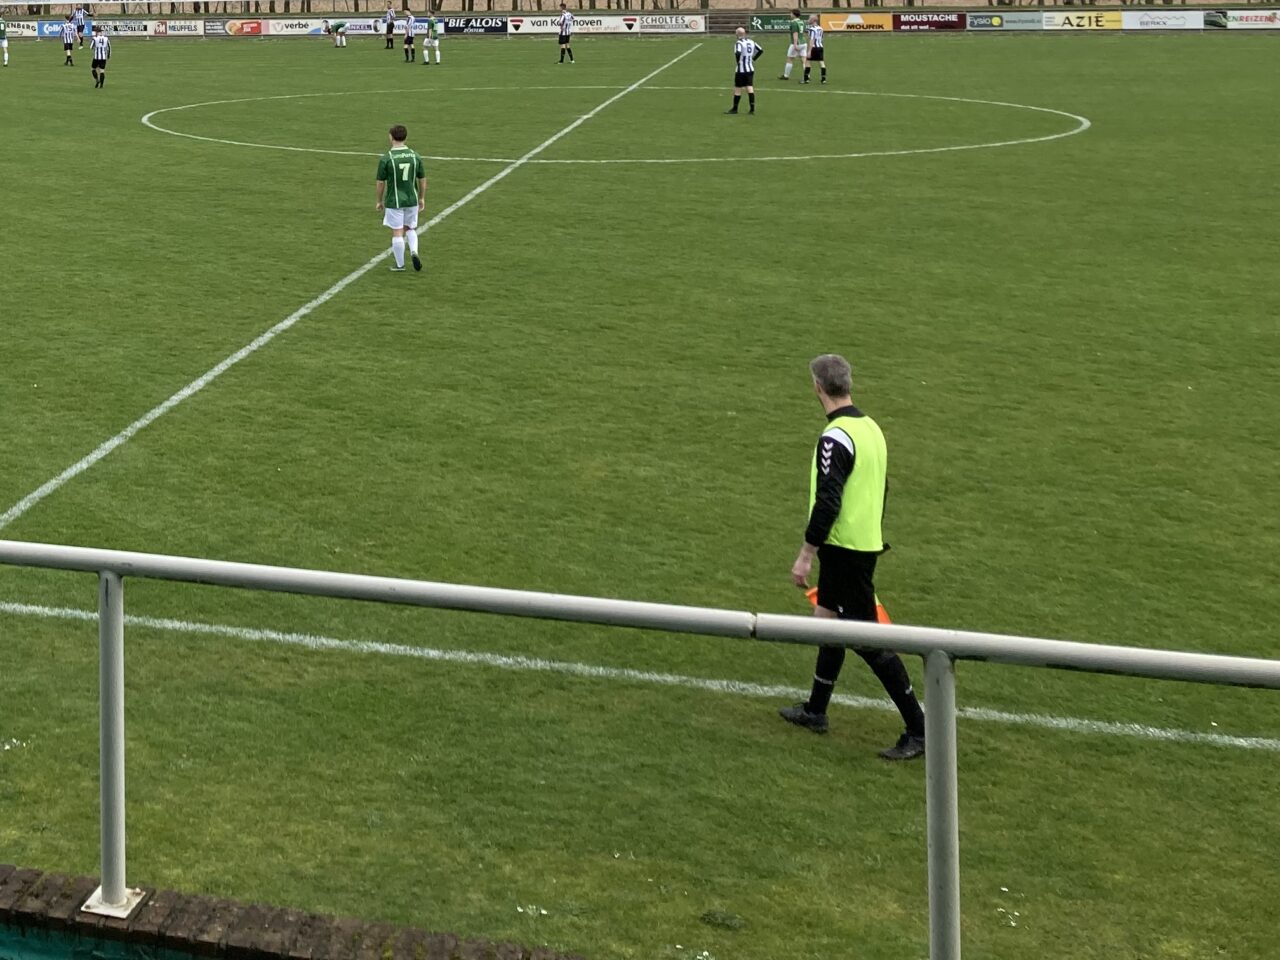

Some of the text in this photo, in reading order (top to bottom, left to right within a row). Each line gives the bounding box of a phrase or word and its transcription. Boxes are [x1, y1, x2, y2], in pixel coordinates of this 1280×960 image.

[284, 21, 310, 30] verbé
[640, 16, 686, 25] SCHOLTES
[1061, 12, 1105, 28] AZIË
[746, 43, 752, 54] 6
[398, 163, 410, 181] 7
